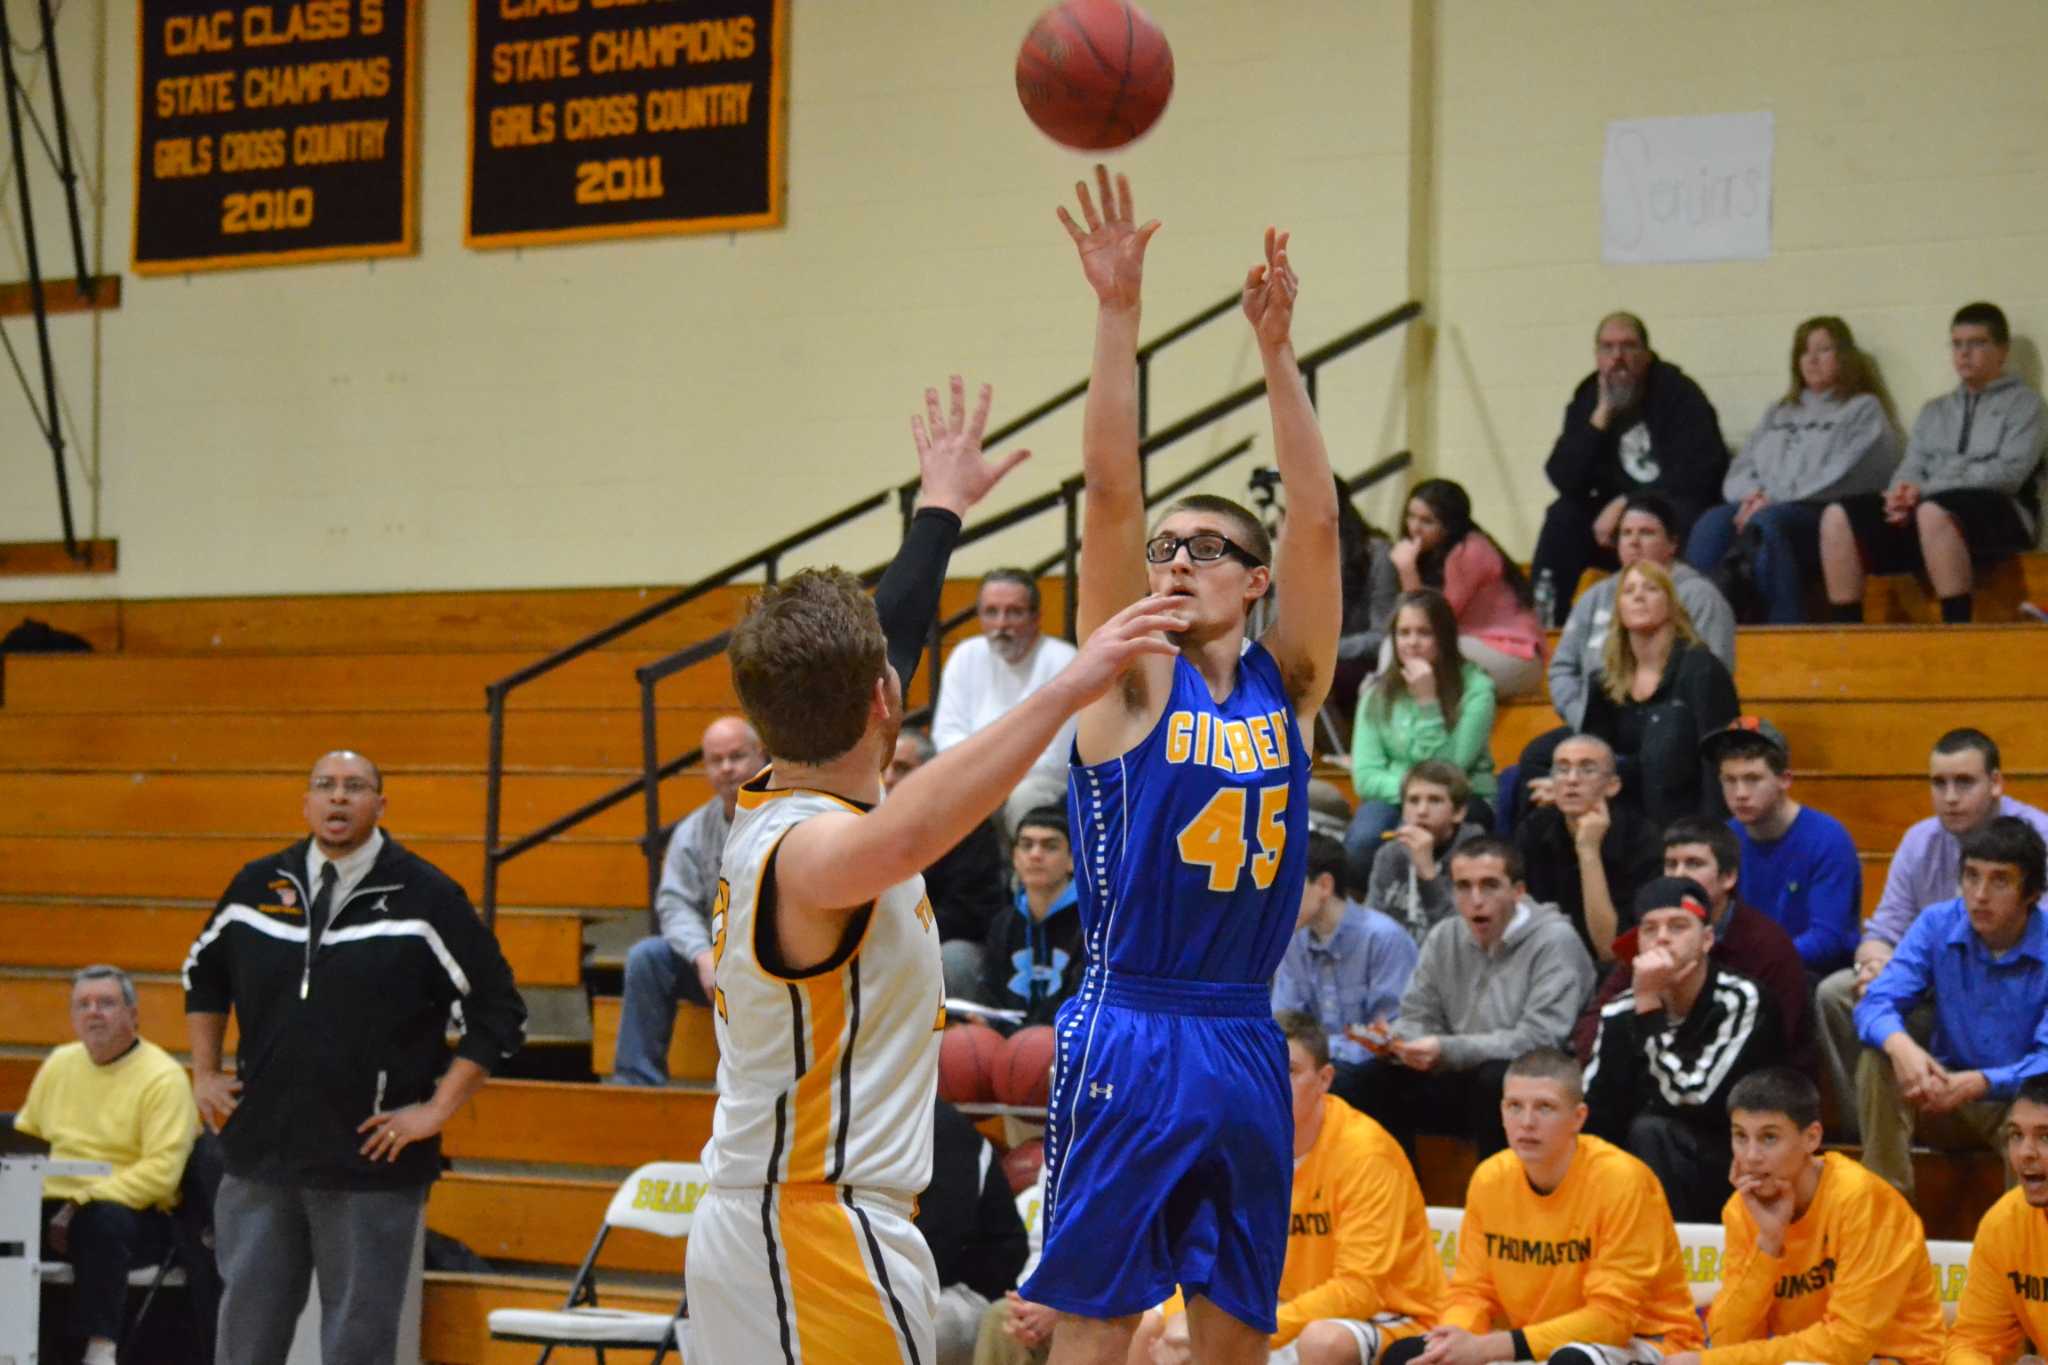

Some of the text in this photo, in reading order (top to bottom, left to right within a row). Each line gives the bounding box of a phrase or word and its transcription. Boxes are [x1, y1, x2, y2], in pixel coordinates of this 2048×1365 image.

[164, 0, 384, 56] CIAC CLASS S
[493, 16, 755, 84] STATE CHAMPIONS
[157, 57, 391, 118] STATE CHAMPIONS
[490, 83, 752, 148] GIRLS CROSS COUNTRY
[154, 119, 389, 178] GIRLS CROSS COUNTRY
[222, 186, 314, 234] 2010
[575, 156, 664, 204] 2011
[1166, 707, 1290, 774] GILBE
[1176, 781, 1290, 891] 45
[632, 1178, 711, 1214] BEAR
